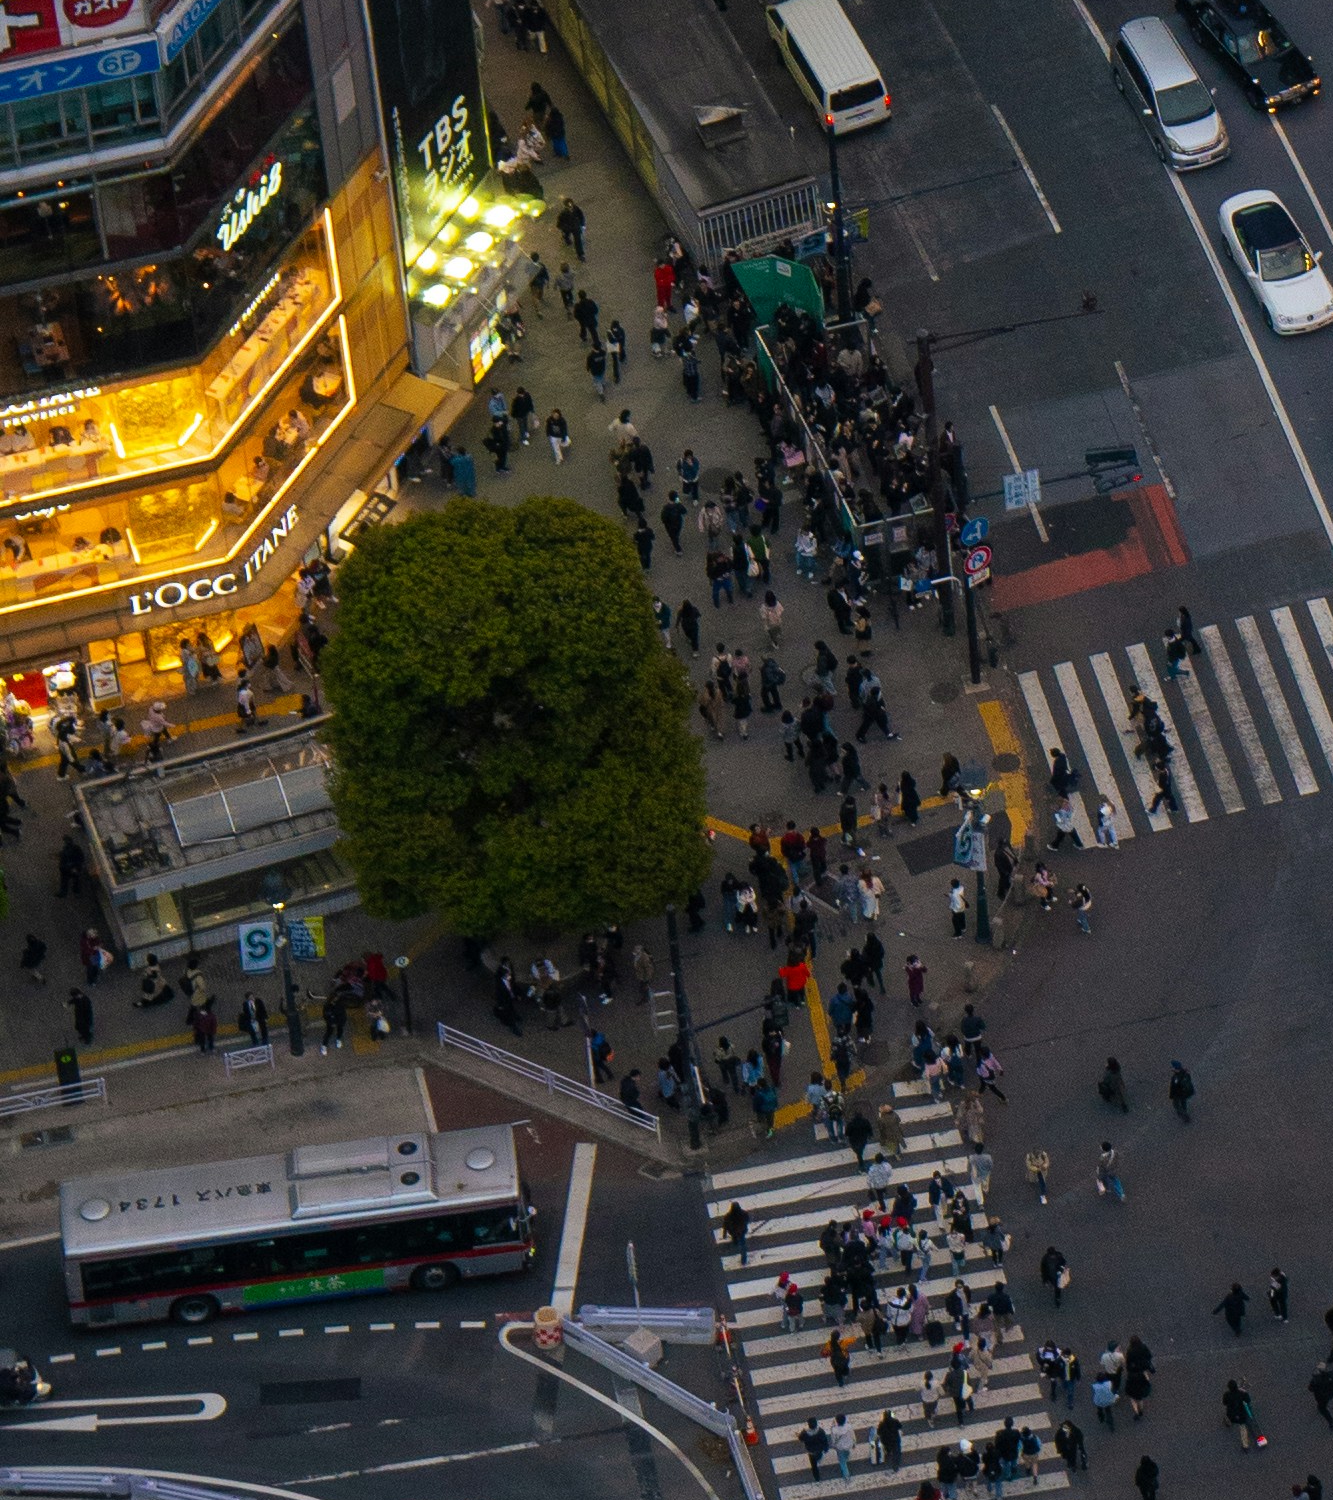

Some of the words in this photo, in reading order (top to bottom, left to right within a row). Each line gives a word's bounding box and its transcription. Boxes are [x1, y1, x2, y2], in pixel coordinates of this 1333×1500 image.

[101, 52, 141, 74] 6F
[418, 93, 469, 170] TBS
[118, 1192, 181, 1215] 1734
[196, 1181, 273, 1206] 東急バス
